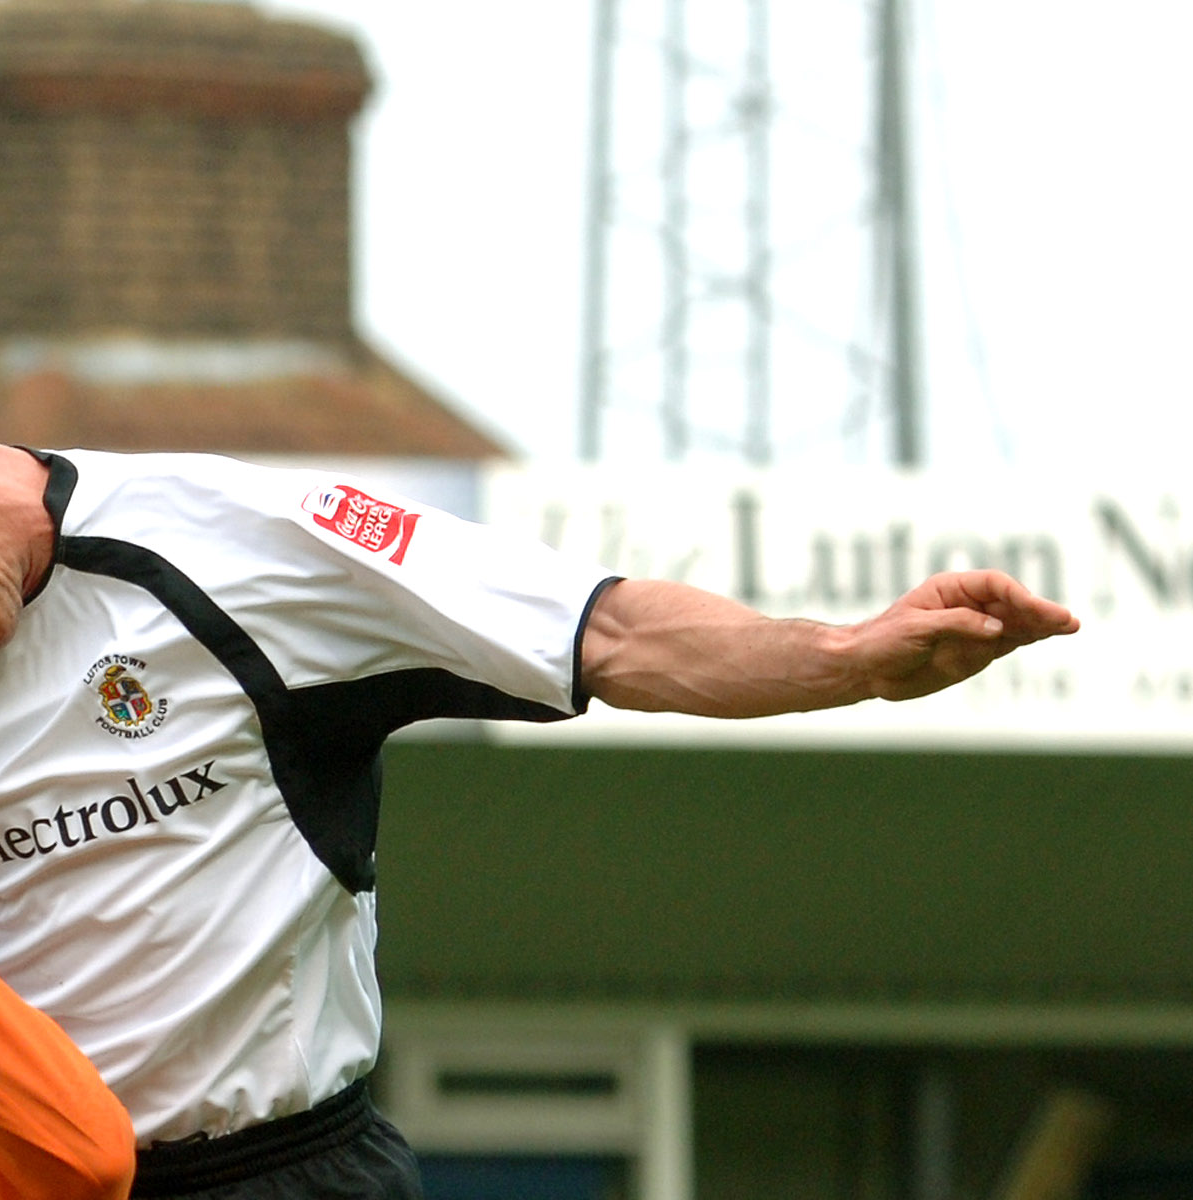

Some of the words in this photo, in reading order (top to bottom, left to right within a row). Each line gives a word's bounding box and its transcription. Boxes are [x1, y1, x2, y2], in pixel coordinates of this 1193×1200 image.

[83, 655, 112, 685] LUTON
[113, 654, 147, 670] TOWN
[95, 716, 154, 739] FOOTBALL
[152, 698, 168, 727] CLUB
